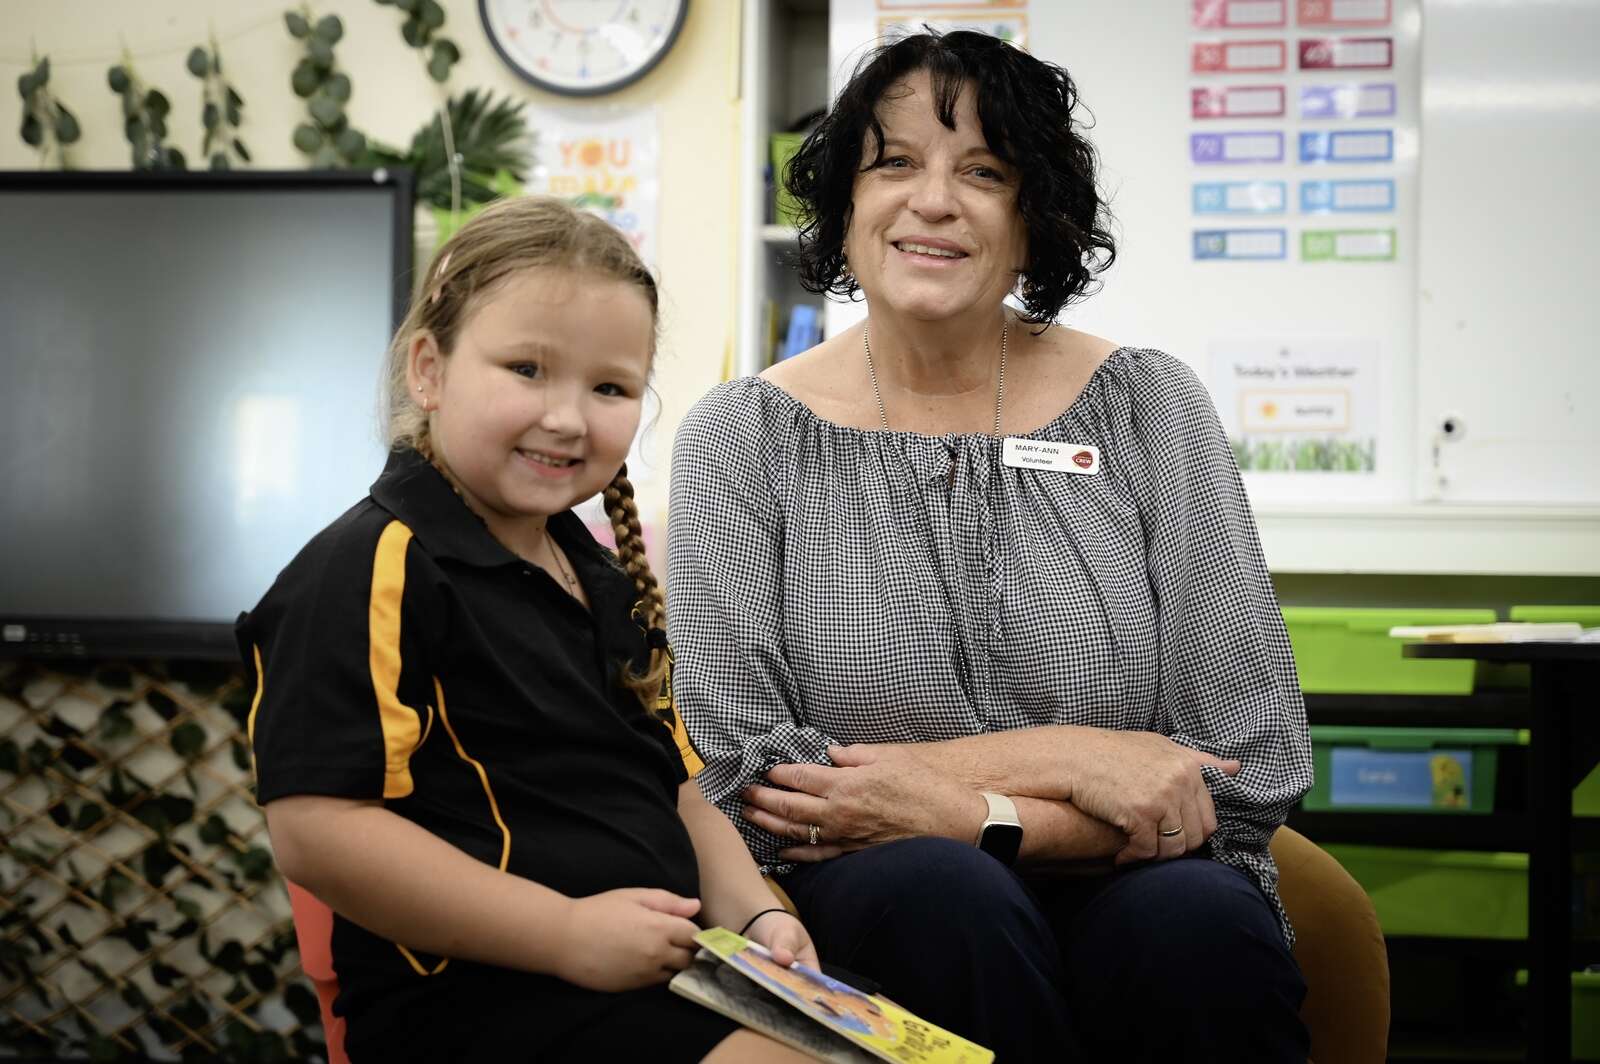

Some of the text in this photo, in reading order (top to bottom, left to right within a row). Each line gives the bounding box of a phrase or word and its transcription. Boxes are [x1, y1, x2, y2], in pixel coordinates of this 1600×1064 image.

[559, 139, 631, 168] YOU
[1015, 444, 1059, 454] MARY-ANN
[1021, 456, 1052, 464] Volunteer
